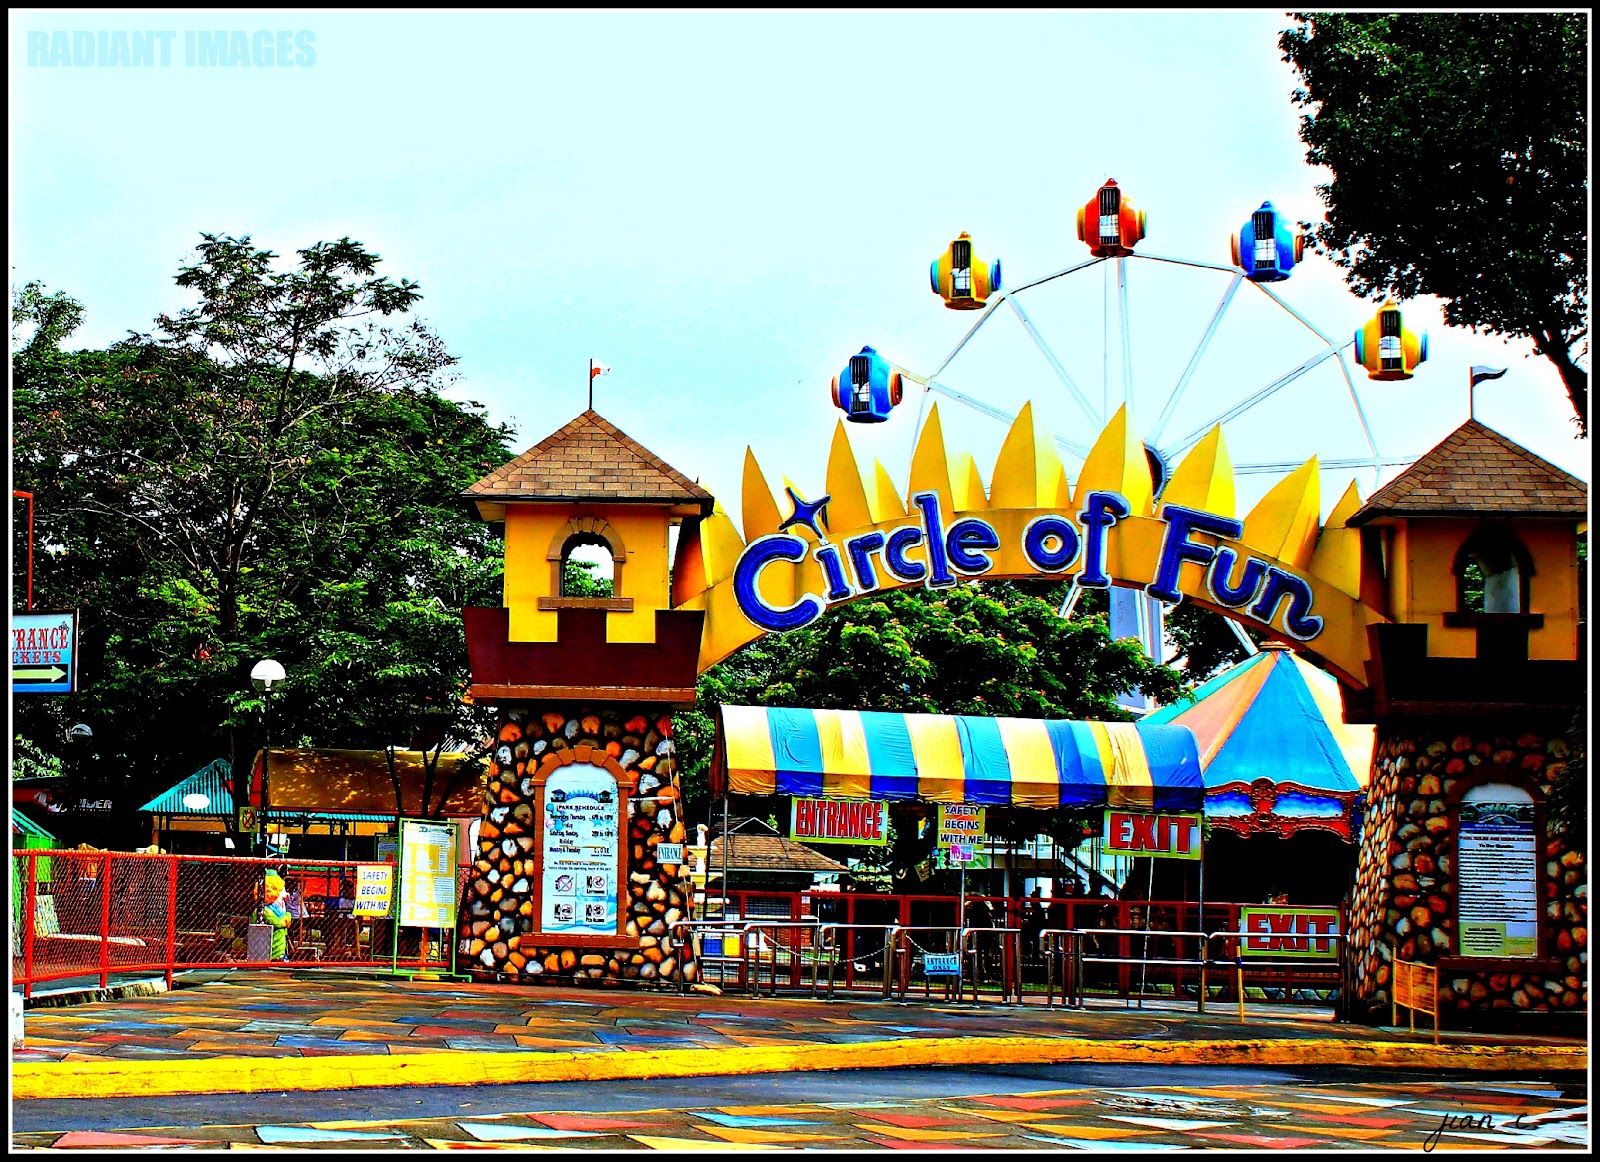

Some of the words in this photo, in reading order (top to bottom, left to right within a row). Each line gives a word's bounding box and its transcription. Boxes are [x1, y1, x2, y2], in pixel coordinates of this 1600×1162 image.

[732, 489, 1000, 634] Circle
[1021, 490, 1130, 589] of
[1144, 502, 1325, 641] Fun
[944, 804, 982, 817] SAFETY
[795, 799, 884, 840] ENTRANCE
[944, 819, 980, 830] BEGINS
[940, 833, 966, 843] WITH
[968, 834, 983, 845] ME
[1108, 812, 1197, 854] EXIT
[658, 847, 682, 860] ENTRANCE
[362, 871, 388, 880] SAFETY
[361, 886, 387, 895] BEGINS
[356, 900, 375, 910] WITH
[376, 901, 388, 910] ME
[1246, 913, 1336, 952] EXIT
